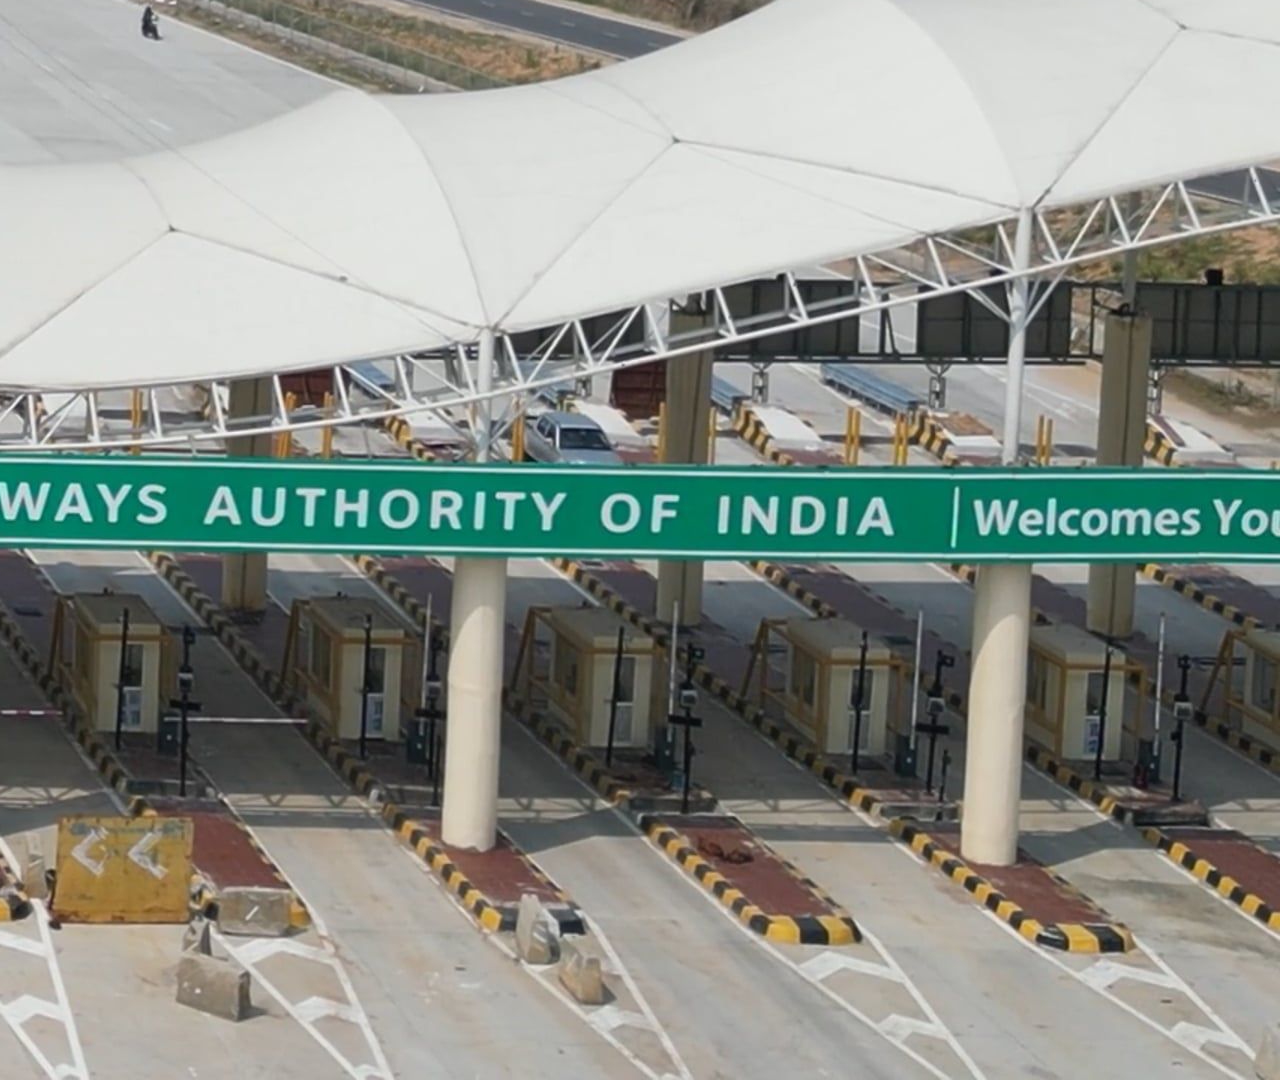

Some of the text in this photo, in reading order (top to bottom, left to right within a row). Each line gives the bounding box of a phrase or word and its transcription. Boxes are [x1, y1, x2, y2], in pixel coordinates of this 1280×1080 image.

[204, 485, 567, 531] AUTHORITY
[600, 493, 680, 533] OF
[718, 495, 894, 536] INDIA
[973, 498, 1201, 537] Welcomes
